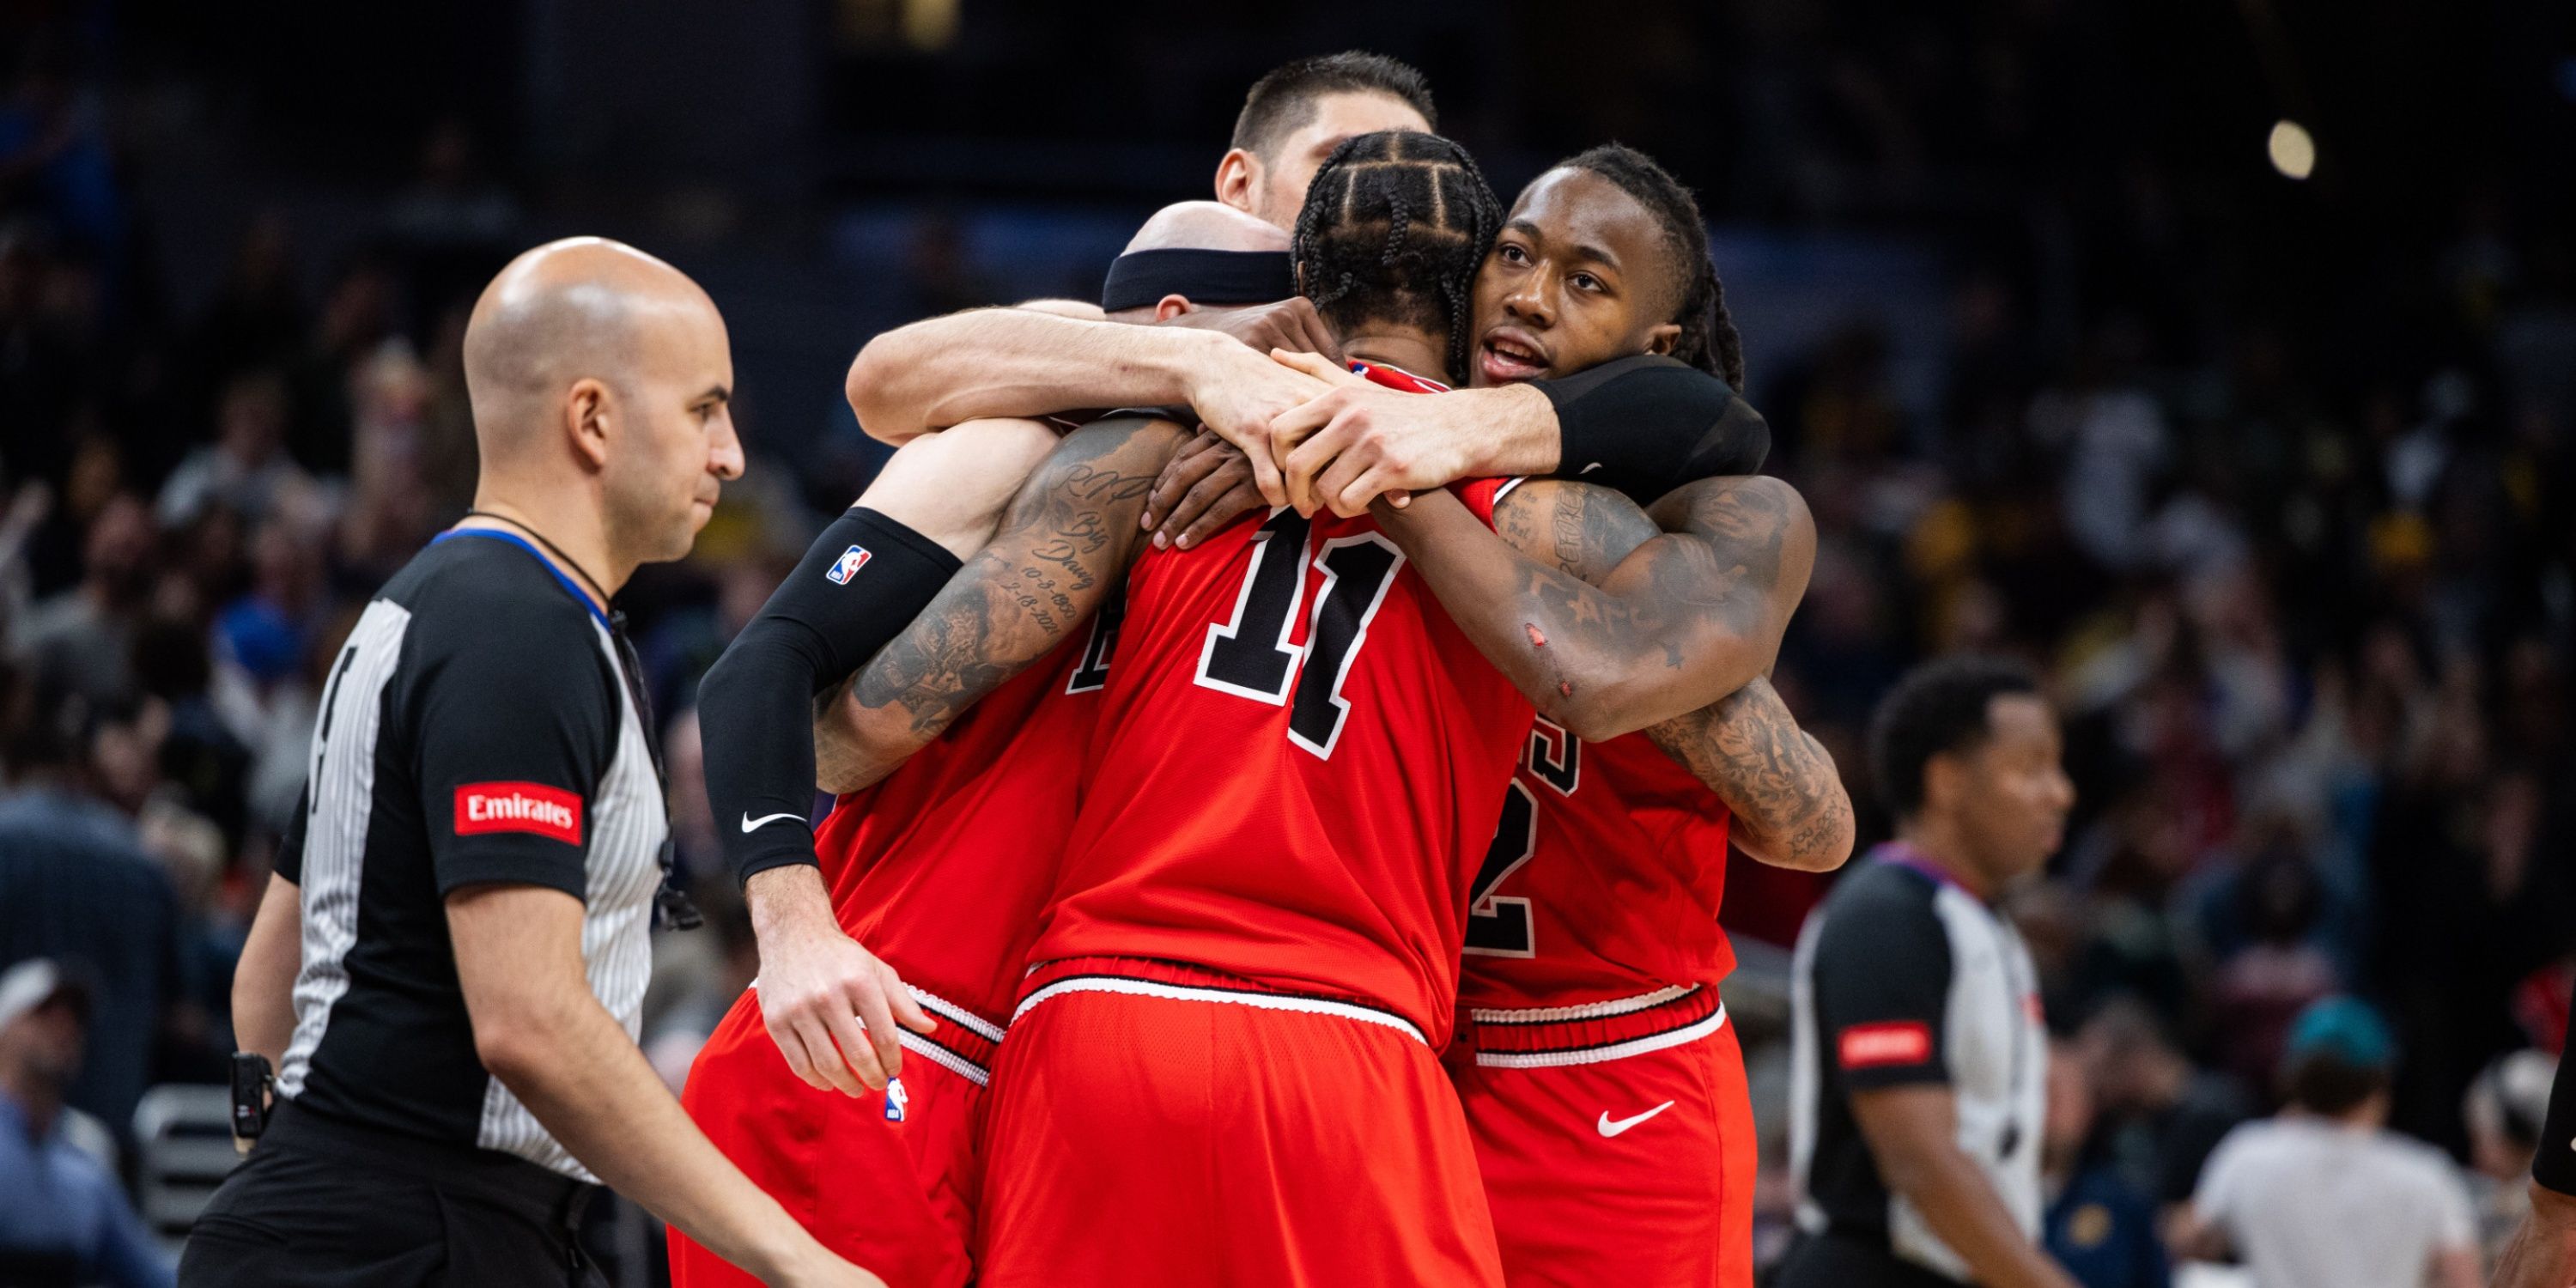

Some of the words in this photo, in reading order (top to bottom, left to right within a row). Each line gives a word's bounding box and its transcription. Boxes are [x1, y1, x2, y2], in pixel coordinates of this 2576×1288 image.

[1057, 511, 1110, 554] Big
[1193, 504, 1408, 762] 11
[468, 793, 573, 829] Emirates
